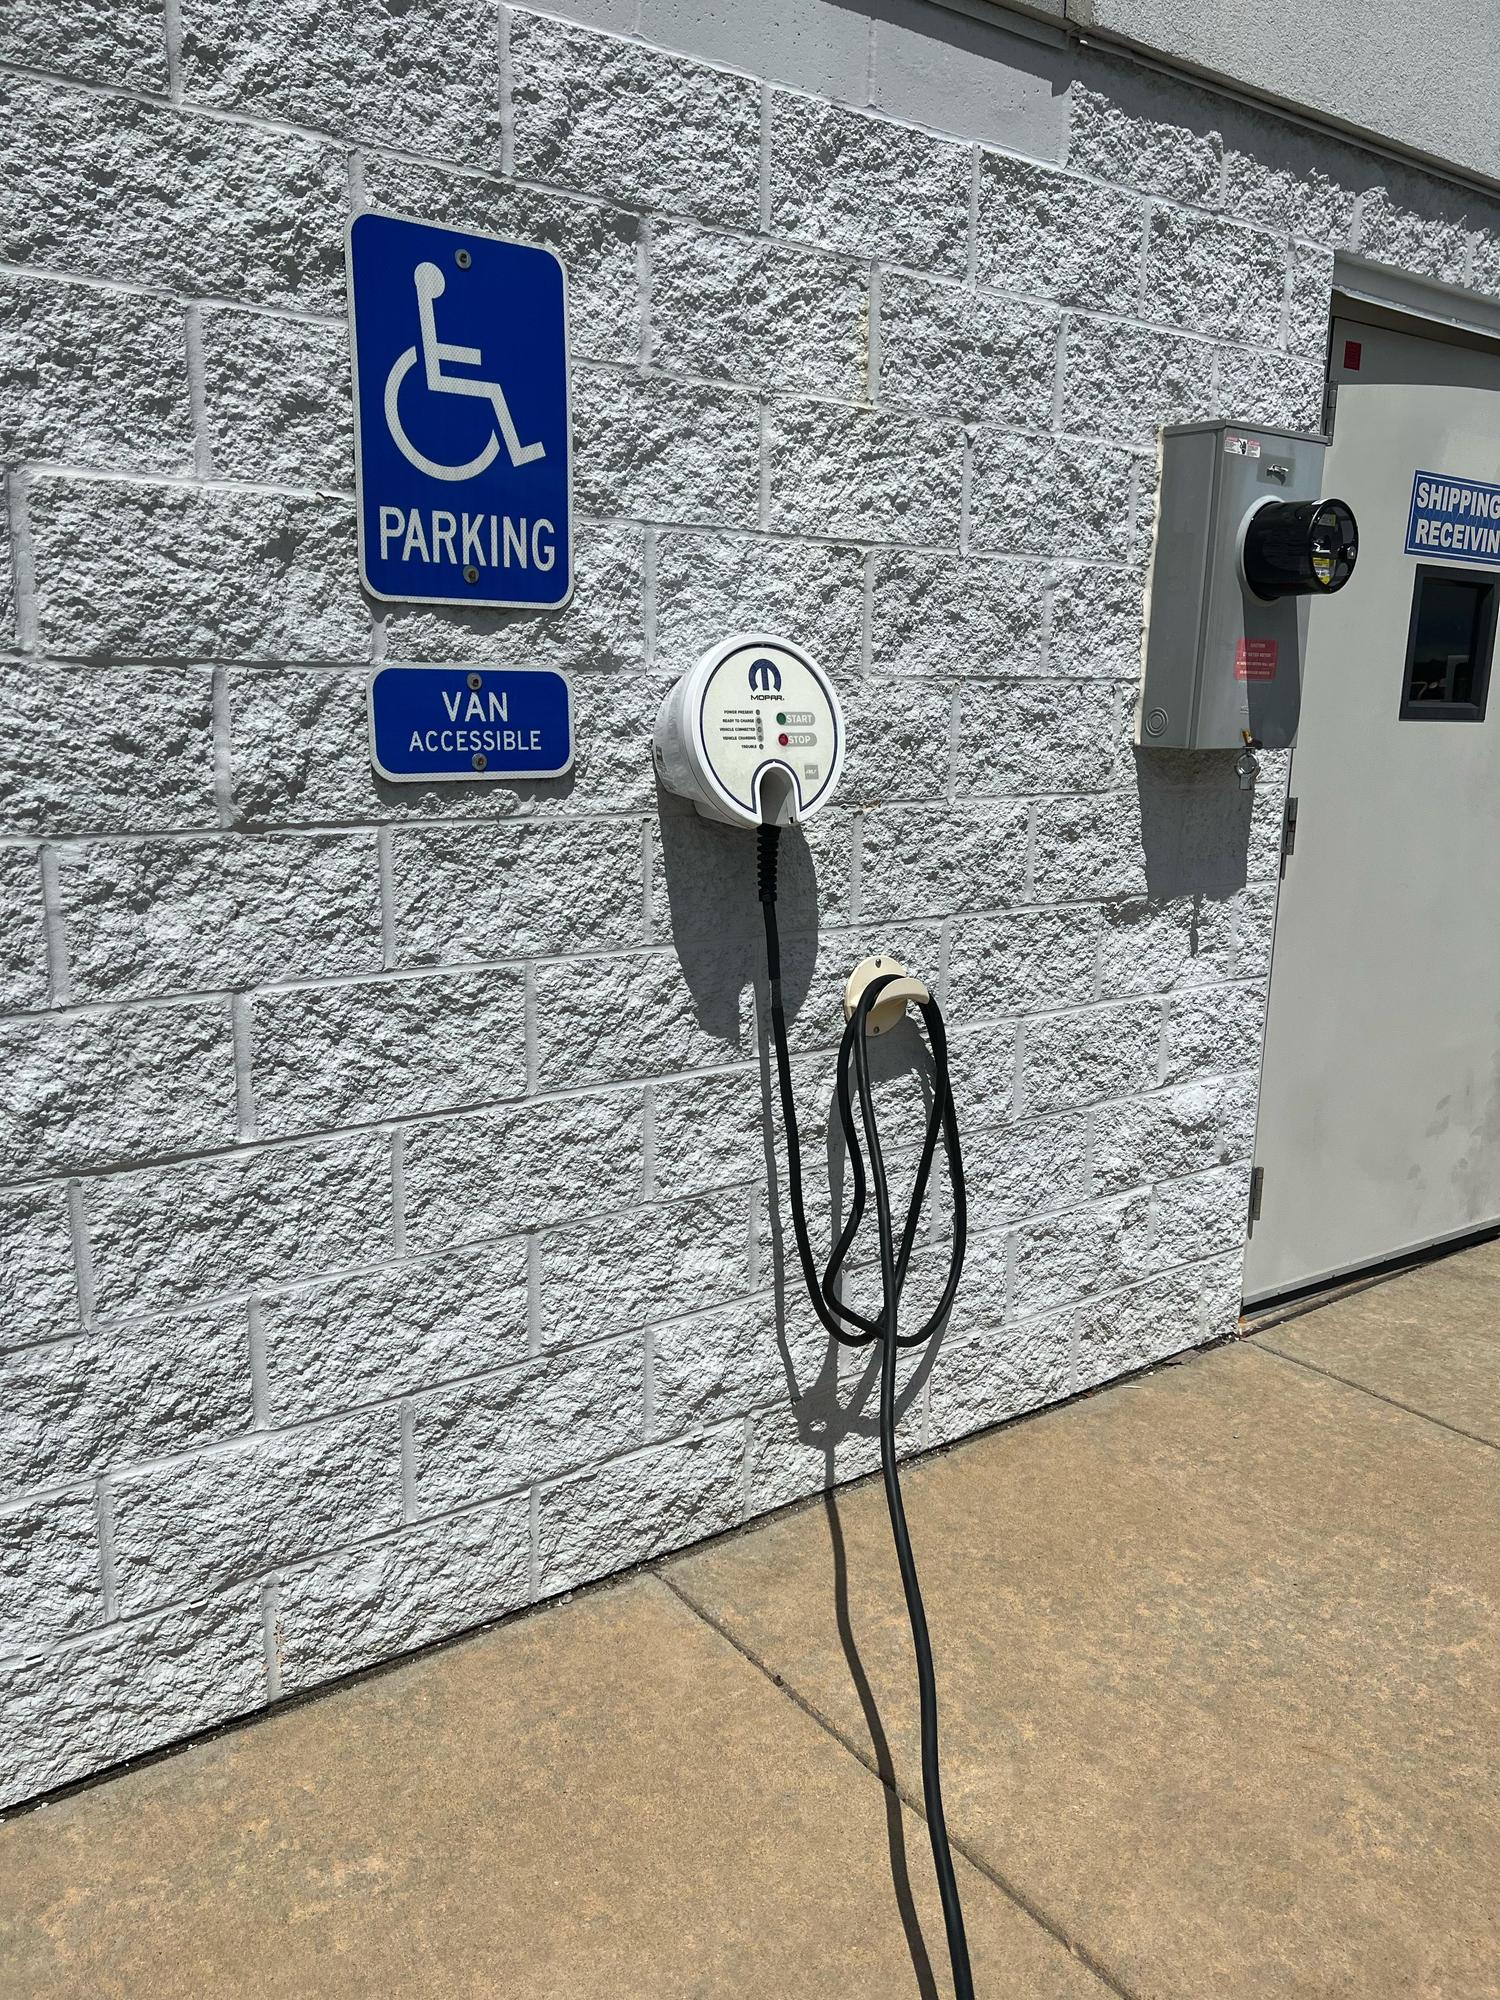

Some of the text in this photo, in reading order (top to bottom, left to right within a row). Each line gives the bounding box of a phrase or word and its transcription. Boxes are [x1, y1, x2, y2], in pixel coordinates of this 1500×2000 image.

[1416, 482, 1500, 519] SHIPPING
[379, 506, 555, 571] PARKING
[1415, 519, 1500, 553] RECEIVIN
[442, 691, 508, 722] VAN
[786, 715, 813, 723] START
[409, 731, 541, 751] ACCESSIBLE
[788, 735, 811, 744] STOP
